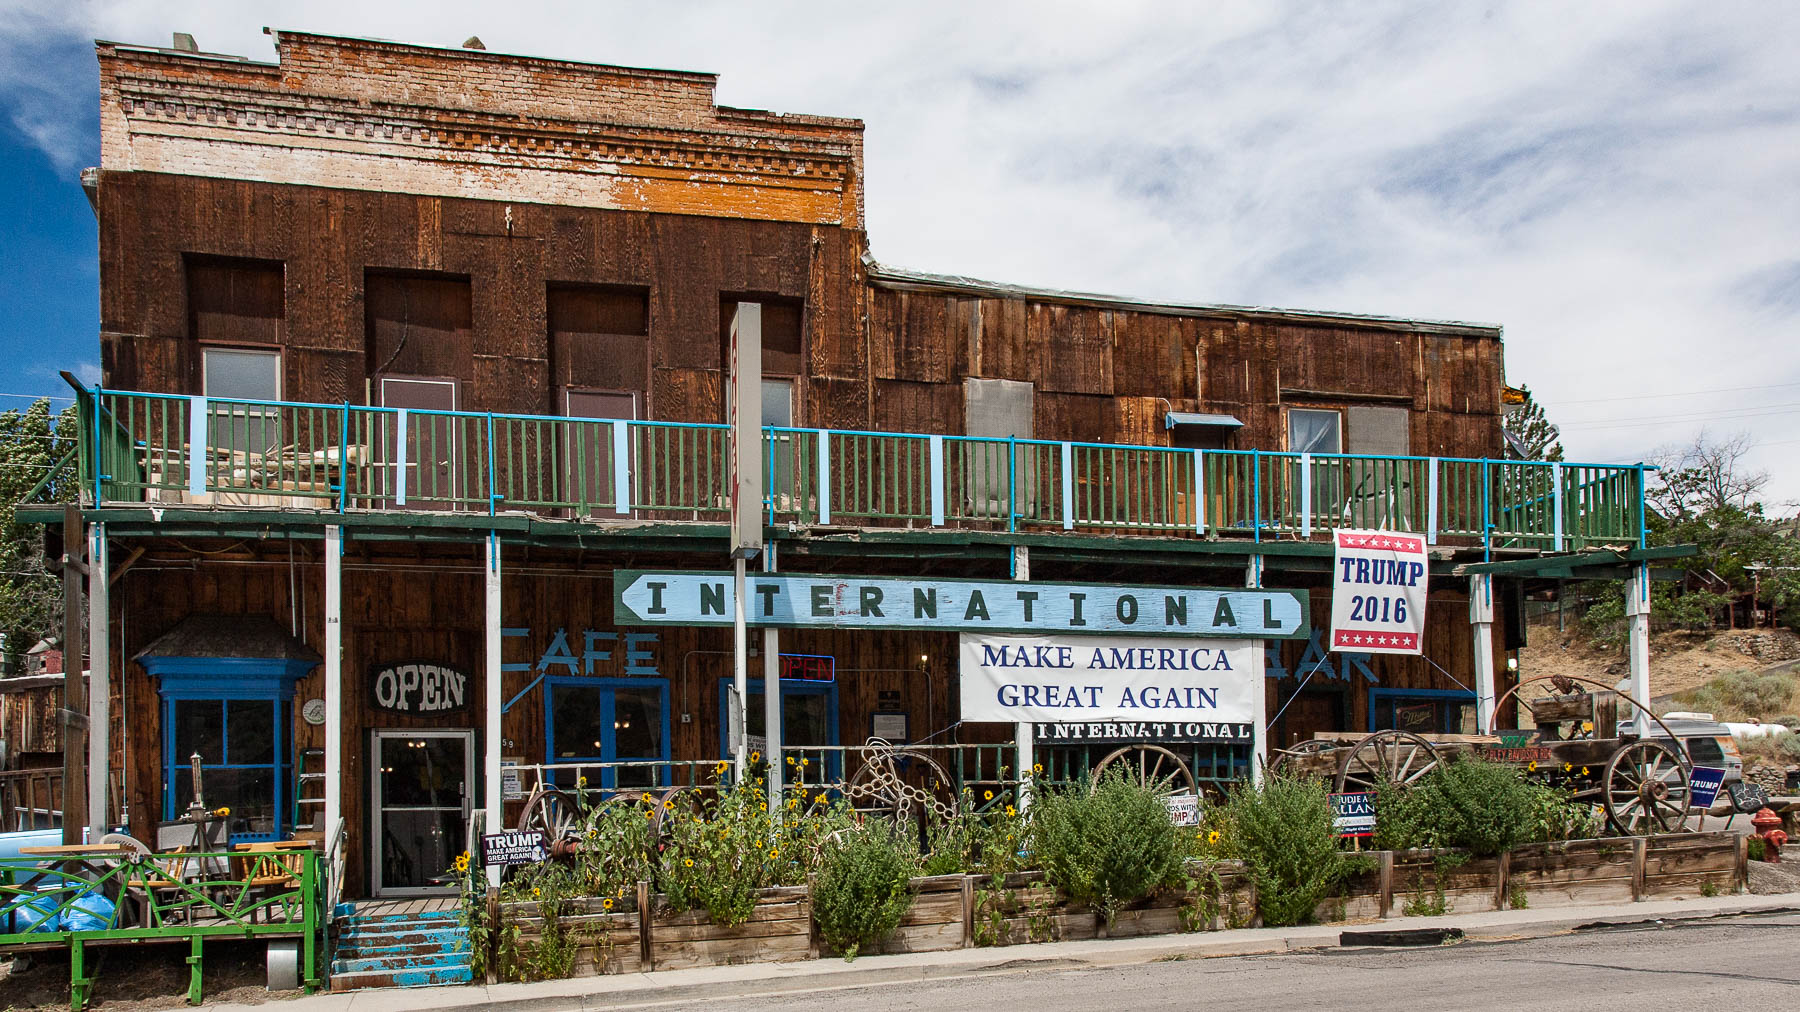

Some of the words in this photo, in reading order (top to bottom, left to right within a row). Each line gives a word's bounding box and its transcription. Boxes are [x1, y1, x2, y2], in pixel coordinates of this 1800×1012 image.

[1340, 557, 1424, 587] TRUMP
[646, 581, 1282, 629] INTERNATIONAL
[1350, 595, 1407, 624] 2016
[980, 644, 1075, 669] MAKE
[1087, 647, 1234, 671] AMERICA
[375, 664, 467, 711] OPEN
[997, 683, 1103, 708] GREAT
[1117, 686, 1220, 709] AGAIN
[1037, 722, 1250, 739] INTERNATIONAL
[1690, 780, 1719, 790] TRUMP
[485, 833, 543, 849] TRUMP
[505, 846, 533, 854] AMERICA
[510, 852, 532, 860] AGAIN!
